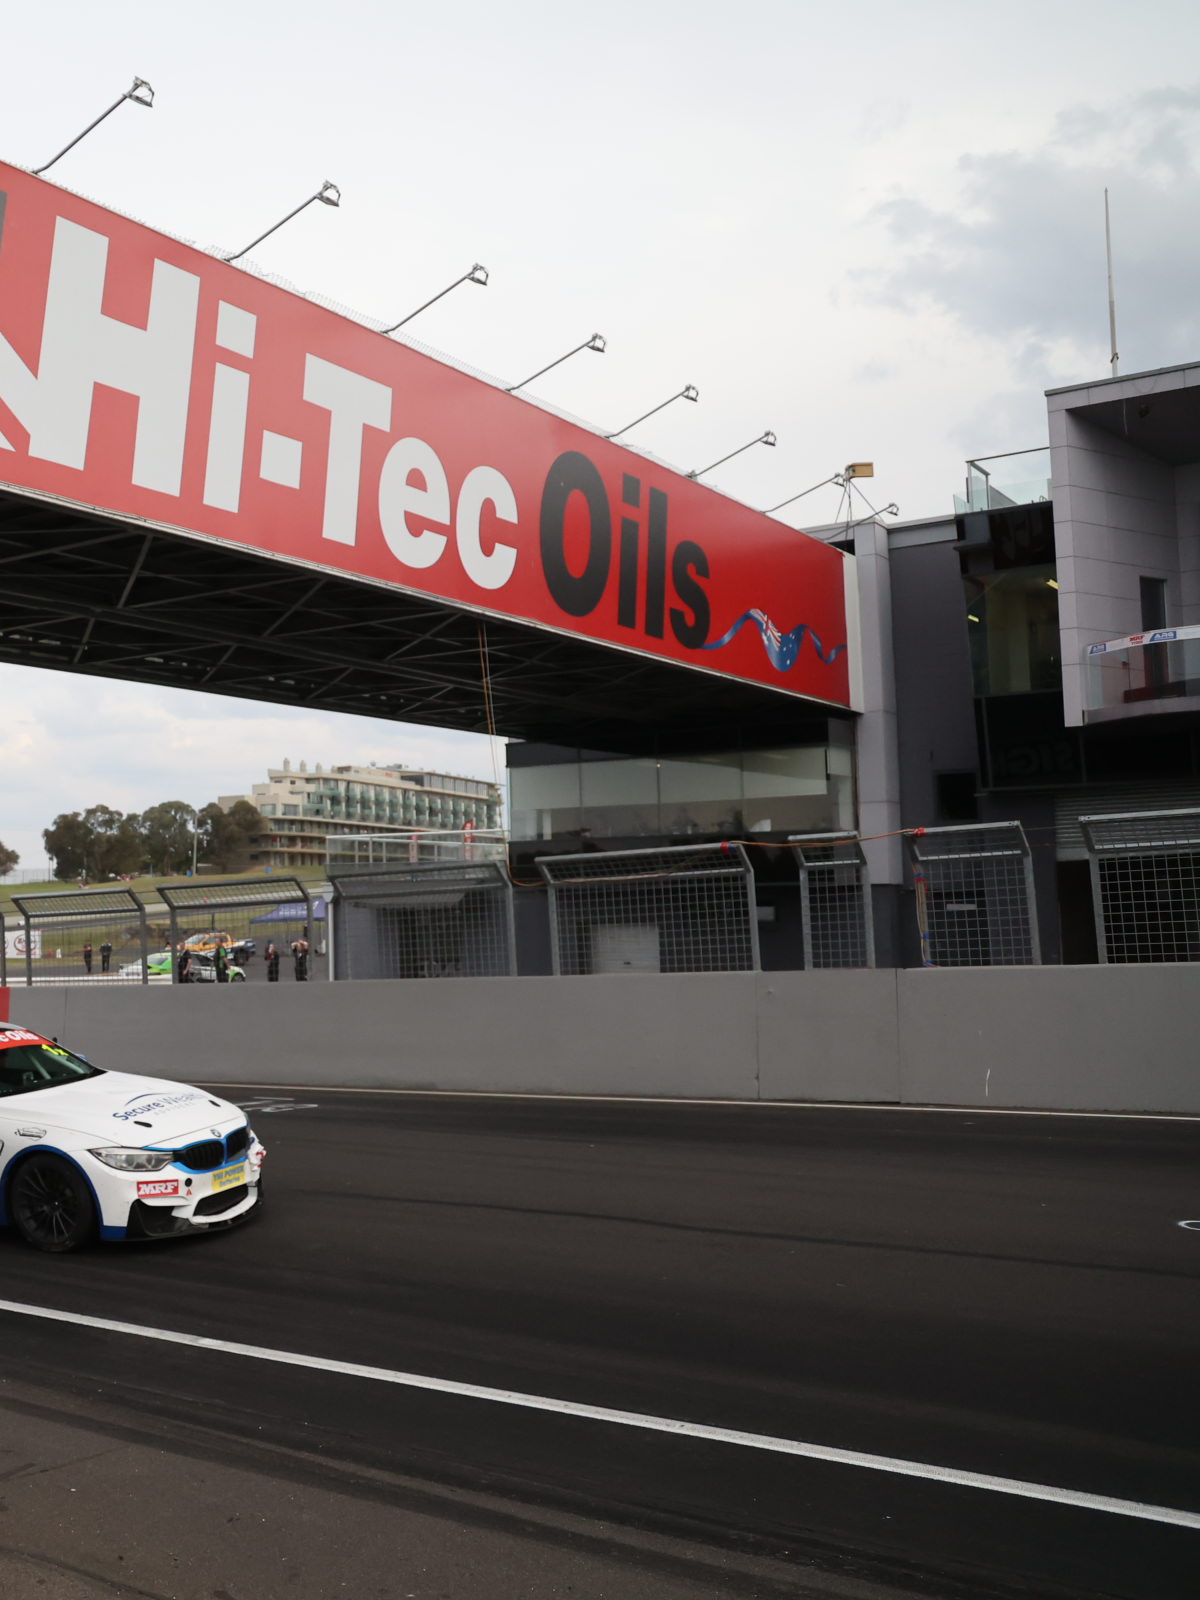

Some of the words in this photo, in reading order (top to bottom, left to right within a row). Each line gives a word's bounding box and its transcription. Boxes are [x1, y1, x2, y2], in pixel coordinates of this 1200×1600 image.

[29, 215, 518, 590] Hi-Tec
[539, 450, 711, 650] Oils
[5, 1030, 39, 1041] Oils
[112, 1101, 165, 1121] Secure
[138, 1181, 178, 1195] MRF
